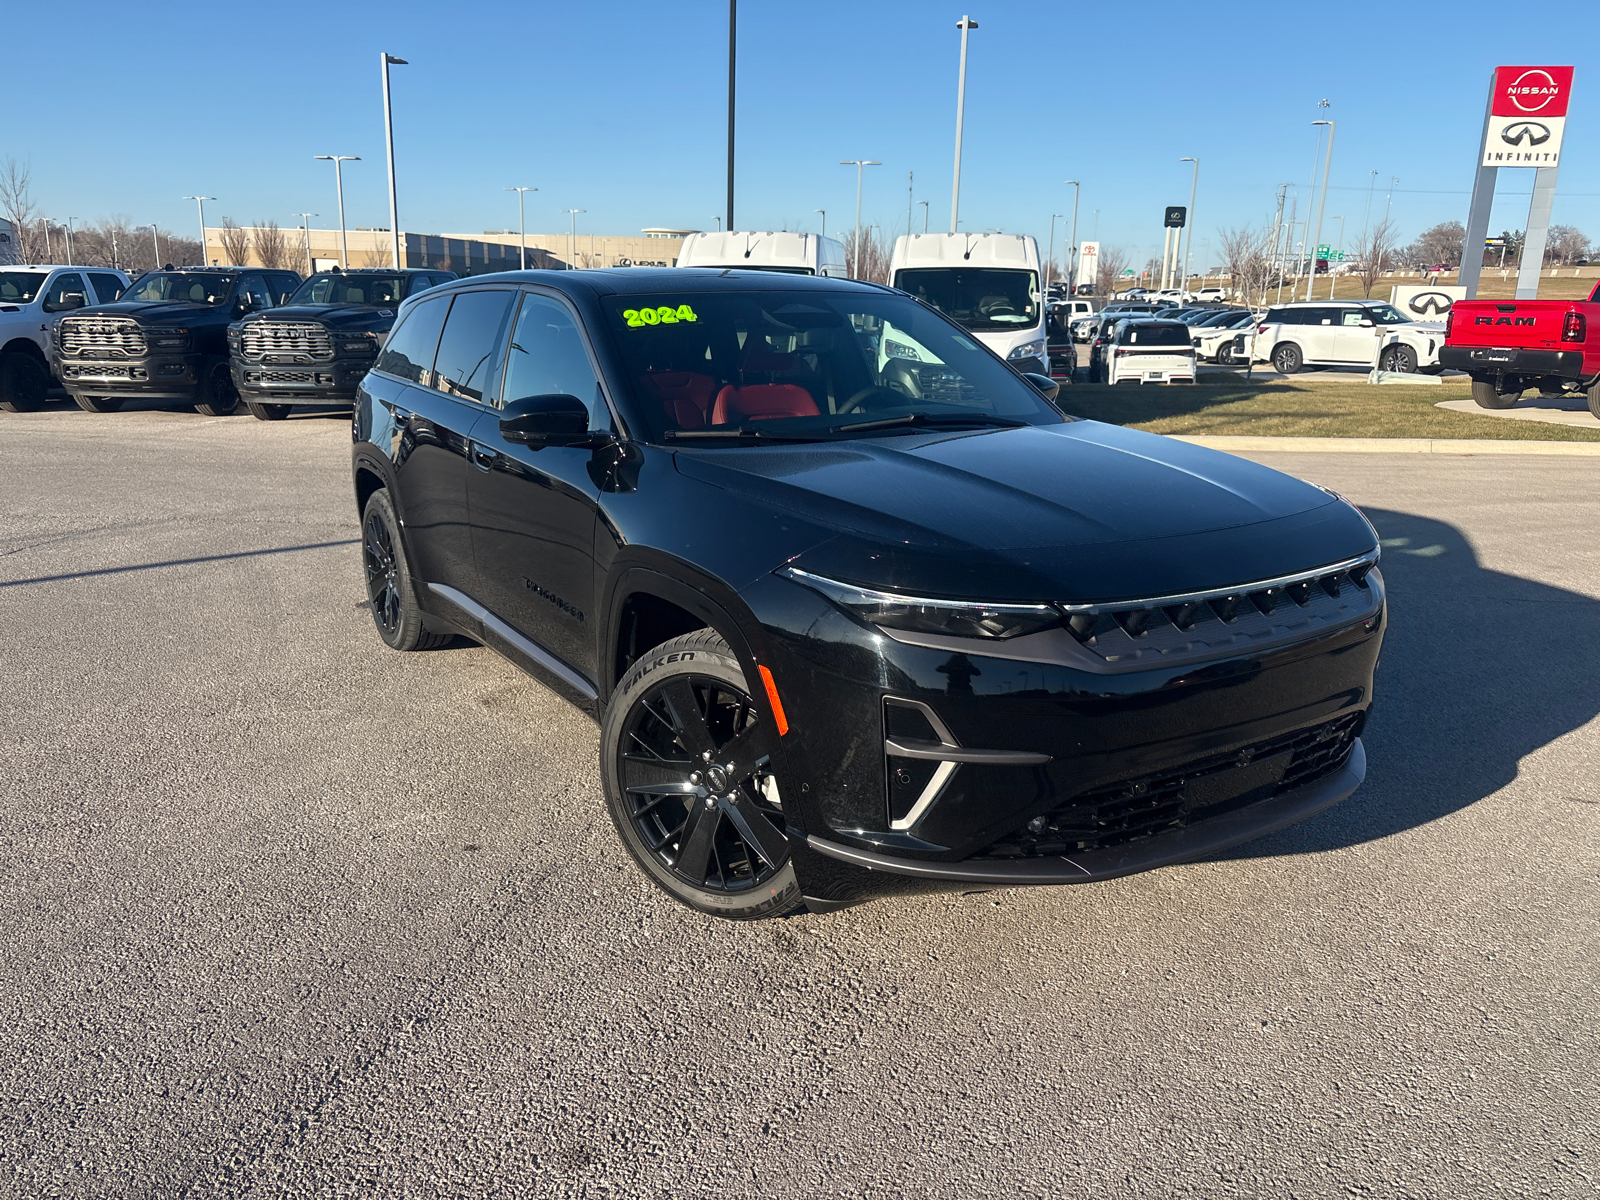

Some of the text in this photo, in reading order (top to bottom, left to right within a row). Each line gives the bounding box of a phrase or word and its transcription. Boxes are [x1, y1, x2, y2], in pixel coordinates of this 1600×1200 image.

[1507, 86, 1559, 95] NISSAN
[1487, 152, 1558, 162] INFINITI
[633, 260, 668, 268] LEXUS
[623, 304, 698, 328] 2024
[1474, 316, 1537, 327] RAM
[77, 325, 119, 334] RAM
[261, 328, 306, 338] RAM
[623, 652, 696, 696] FALKEN
